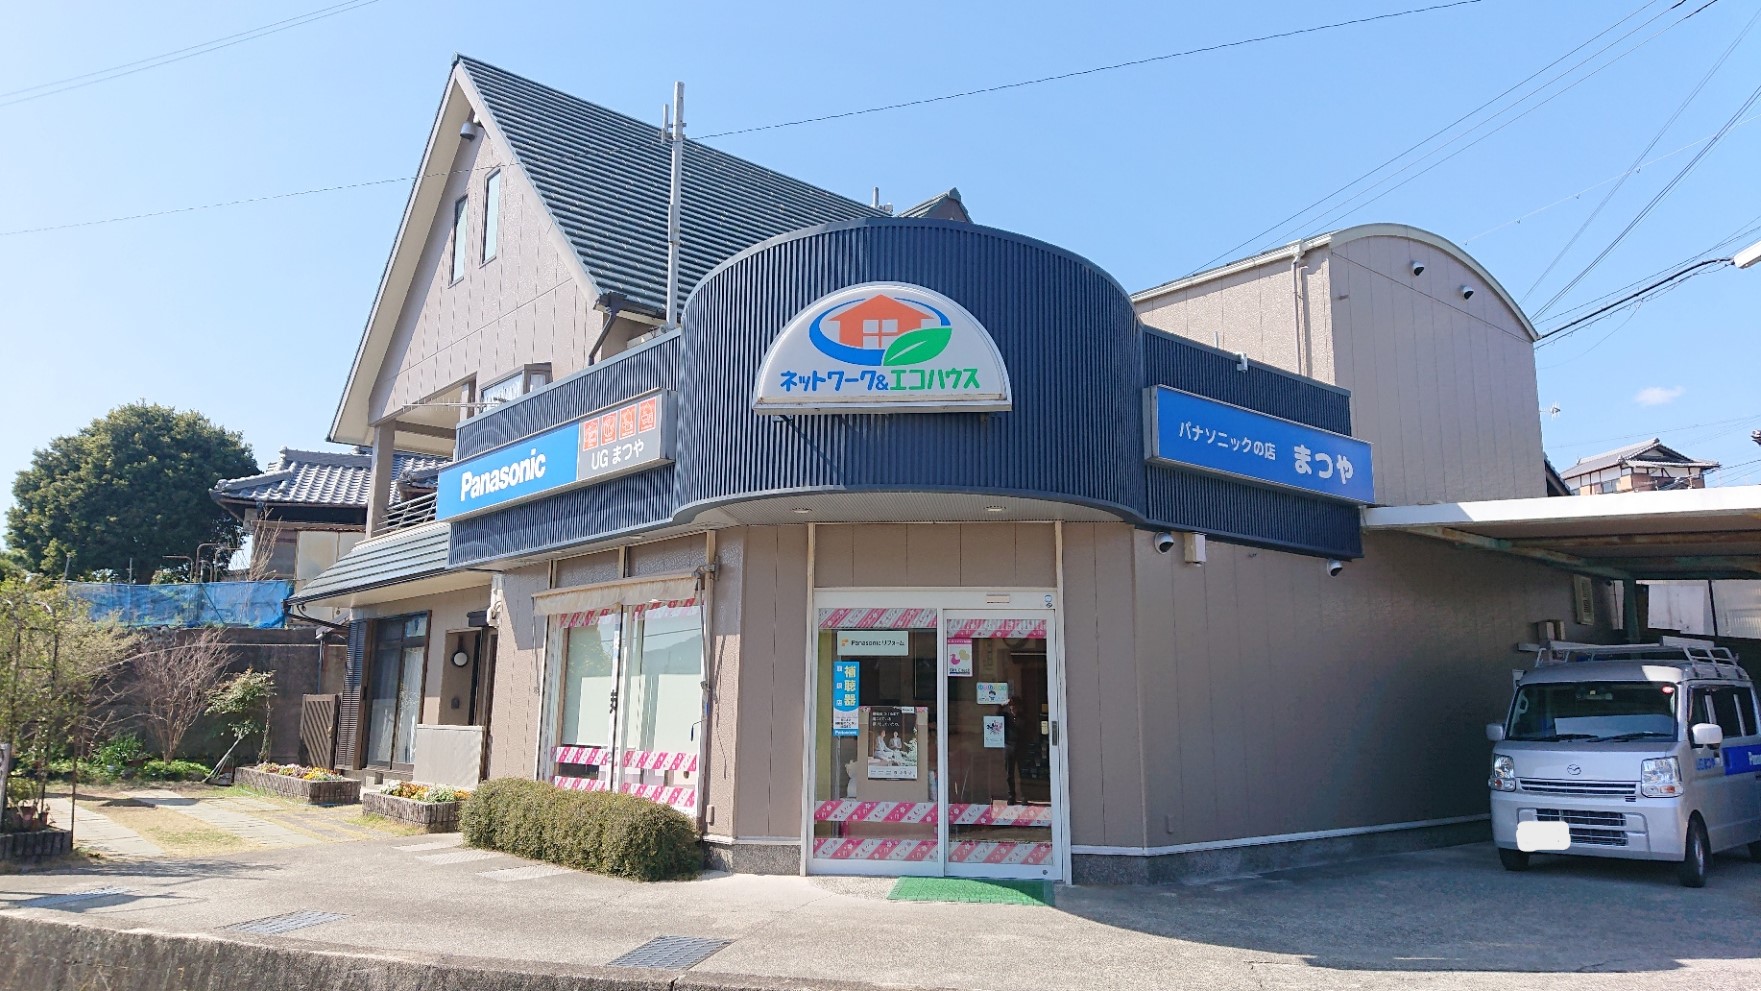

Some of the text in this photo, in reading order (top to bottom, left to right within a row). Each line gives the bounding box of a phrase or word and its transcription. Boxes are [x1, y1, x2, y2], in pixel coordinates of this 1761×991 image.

[780, 367, 980, 392] ネットワーク&エコハウス
[591, 449, 609, 471] UG
[612, 438, 645, 465] まつや
[1178, 421, 1354, 485] パナソニックの店 まつや
[460, 448, 547, 502] Panasonic
